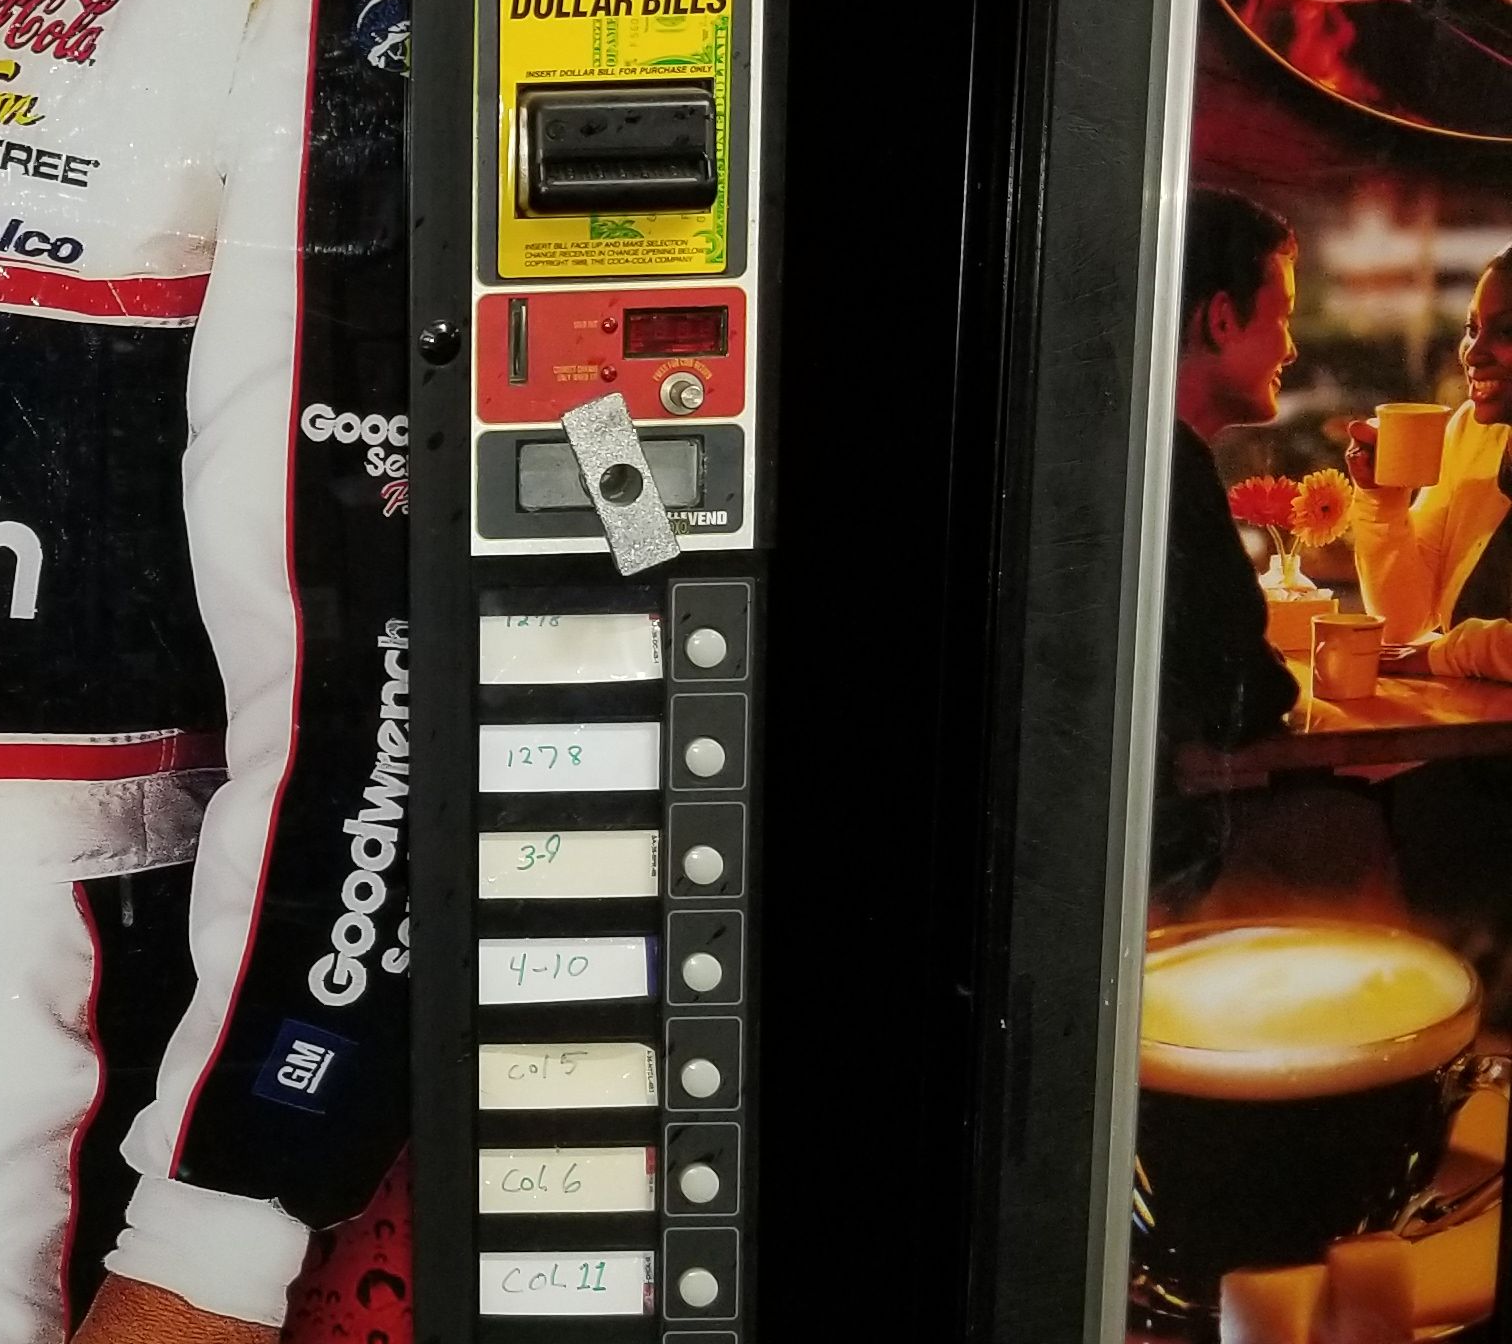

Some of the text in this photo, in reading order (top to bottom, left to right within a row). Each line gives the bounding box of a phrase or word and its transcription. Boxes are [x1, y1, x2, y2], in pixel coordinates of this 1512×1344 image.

[525, 64, 713, 79] INSERT DOLLAR BILL FOR PURCHASE ONLY
[508, 744, 583, 769] 1278
[509, 952, 589, 986] 4-10
[276, 1039, 328, 1090] GM
[560, 1051, 589, 1075] 5
[563, 1162, 582, 1193] 6
